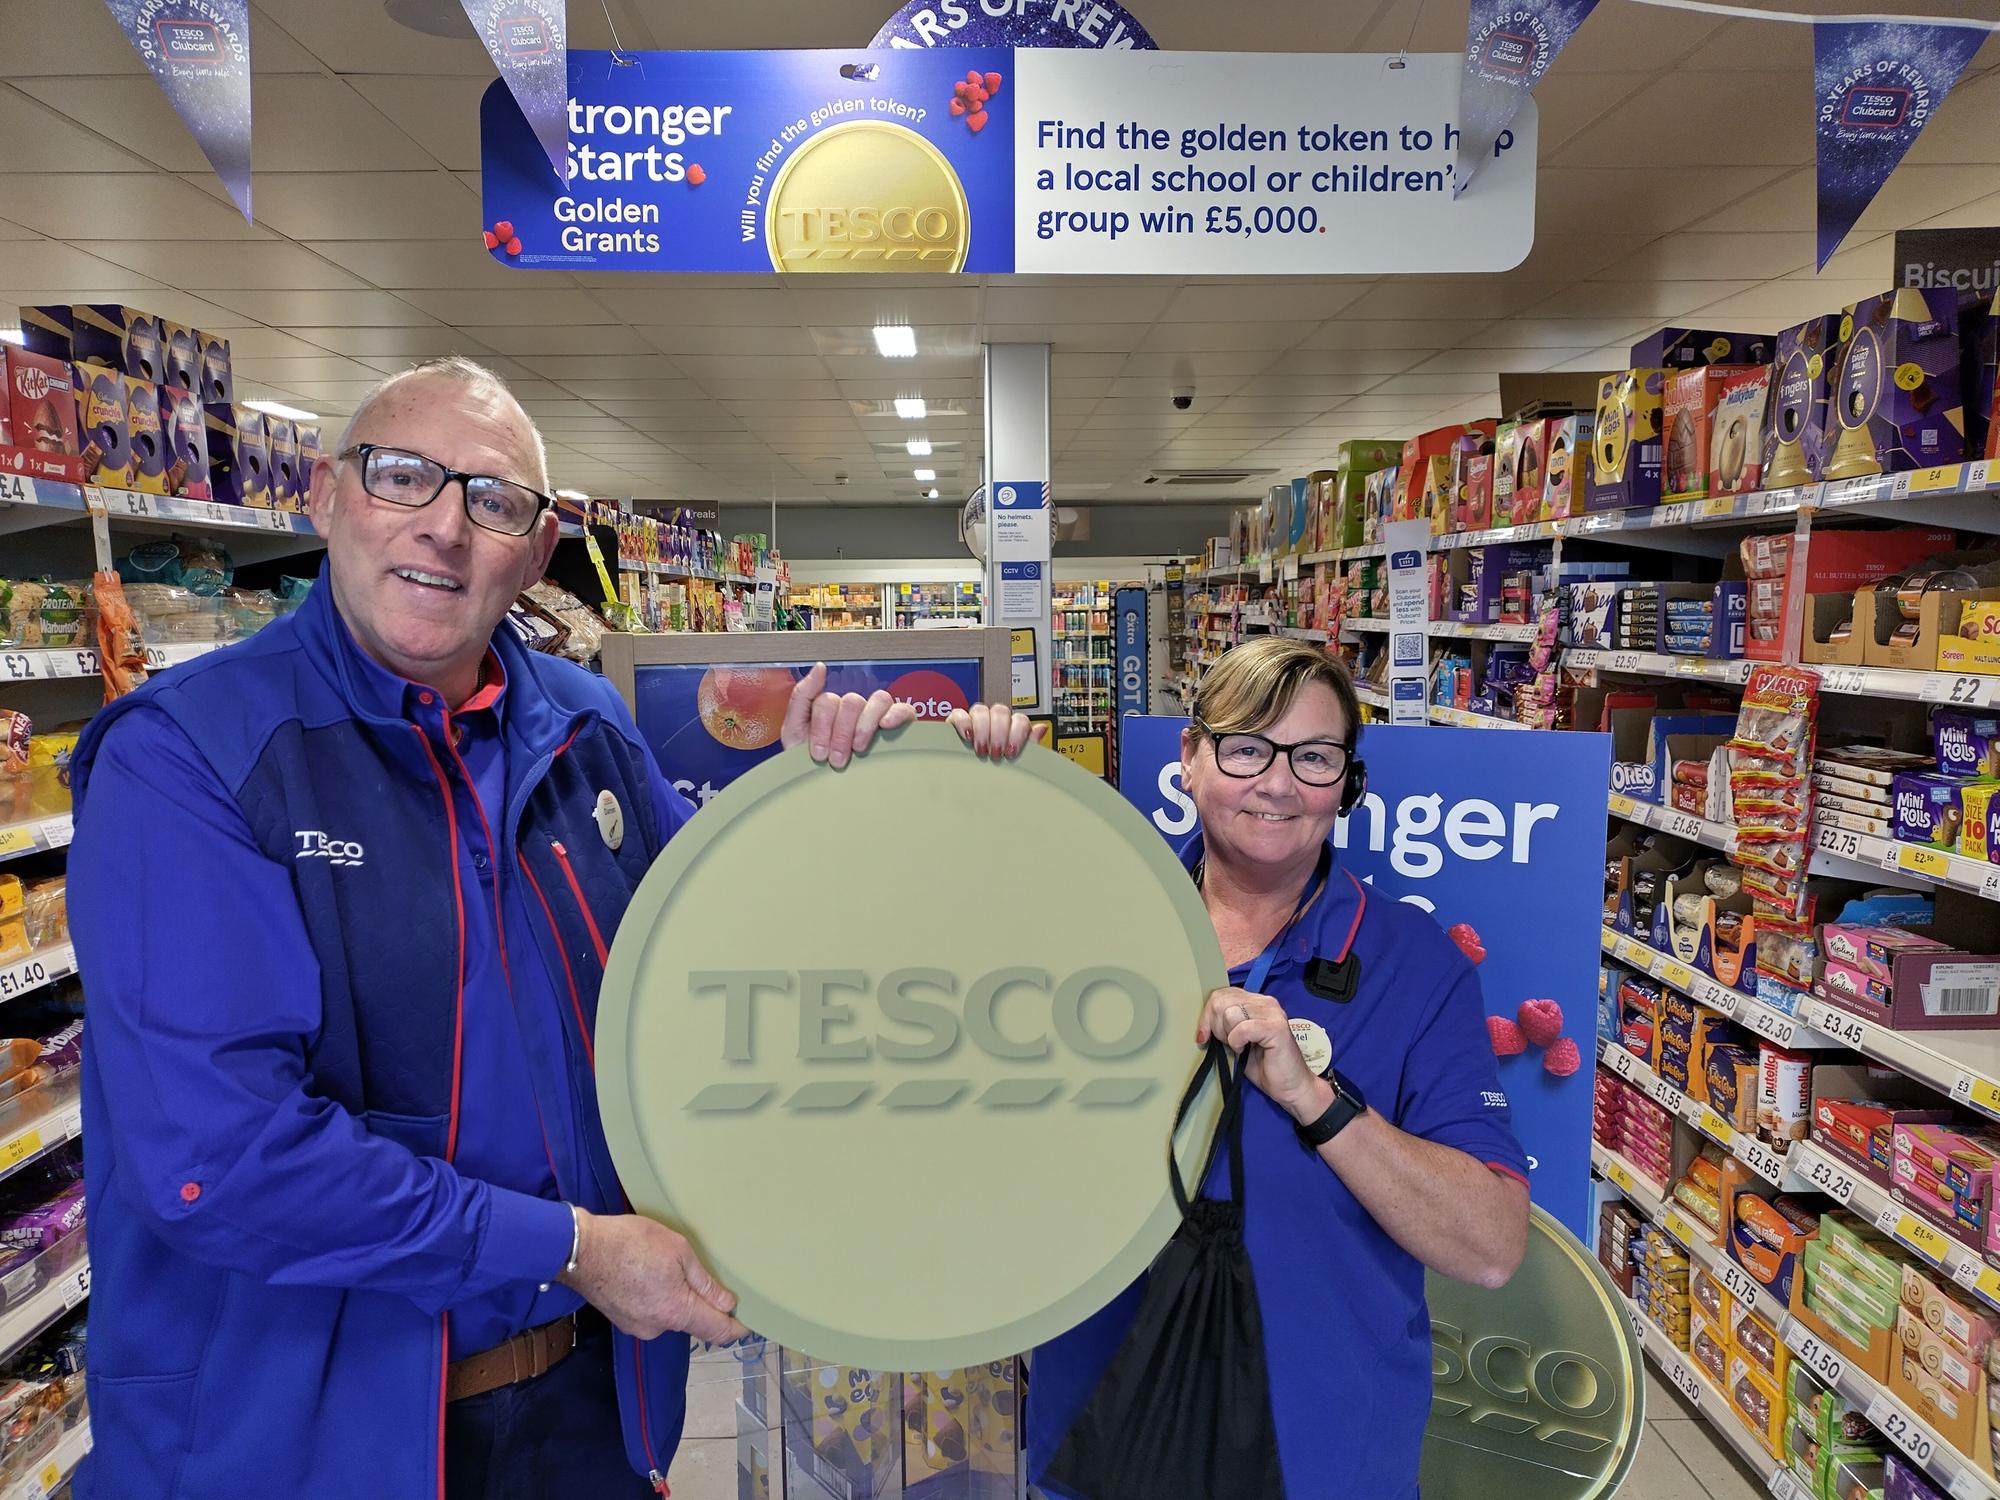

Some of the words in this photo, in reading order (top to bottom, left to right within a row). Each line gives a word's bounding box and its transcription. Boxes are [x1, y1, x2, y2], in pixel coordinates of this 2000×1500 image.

[172, 28, 204, 39] TESCO
[511, 25, 534, 34] TESCO
[140, 40, 157, 59] 30
[171, 40, 215, 52] Clubcard
[488, 39, 501, 57] 30
[510, 36, 542, 46] Clubcard
[1469, 45, 1480, 61] 30
[1475, 12, 1511, 42] YEARS
[1514, 11, 1530, 23] OF
[1528, 17, 1550, 77] REWARDS
[1501, 41, 1523, 52] TESCO
[1491, 50, 1523, 64] Clubcard
[1820, 105, 1834, 122] 30
[1827, 64, 1873, 100] YEARS
[1876, 60, 1898, 73] OF
[1898, 64, 1929, 128] REWARDS
[1862, 95, 1894, 104] TESCO
[810, 97, 865, 127] golden
[869, 95, 927, 124] token?
[1852, 106, 1896, 116] Clubcard
[566, 97, 733, 146] tronger
[781, 118, 808, 143] the
[1038, 120, 1105, 149] Find
[1116, 122, 1170, 150] the
[1181, 123, 1286, 158] golden
[1297, 124, 1388, 151] token
[1399, 125, 1433, 150] to
[1445, 123, 1514, 157] hp
[756, 138, 784, 174] find
[1037, 169, 1054, 190] a
[1066, 163, 1139, 191] local
[1151, 164, 1255, 192] school
[1267, 171, 1302, 192] or
[746, 175, 765, 206] you
[553, 196, 659, 223] Golden
[741, 209, 757, 242] Will
[780, 206, 957, 242] TESCO
[1037, 210, 1129, 240] group
[1140, 205, 1194, 233] win
[1205, 206, 1326, 239] £5,000.
[561, 227, 660, 253] Grants
[1904, 259, 2000, 289] Biscui
[20, 367, 48, 399] KitKat
[92, 405, 121, 419] crunchie
[1604, 406, 1619, 423] Mini
[1603, 420, 1620, 436] eggs
[30, 458, 41, 471] 1x
[1973, 469, 1984, 481] £6
[1897, 480, 1907, 490] £6
[1929, 470, 1942, 481] £4
[0, 475, 25, 501] £4
[127, 492, 149, 516] £4
[692, 509, 717, 519] reals
[1664, 505, 1683, 524] £12
[271, 511, 286, 530] £4
[77, 651, 101, 675] £2
[146, 647, 166, 667] 0p
[1576, 652, 1596, 666] £2.55
[1615, 656, 1638, 670] £2.50
[1942, 650, 1965, 660] Soreen
[5, 654, 35, 678] £2
[1123, 656, 1141, 705] GOT
[1823, 667, 1865, 692] £1.75
[1949, 677, 1981, 703] £2
[895, 696, 952, 718] Vote
[1069, 744, 1085, 754] 1/3
[1942, 743, 1976, 763] ROLLS
[1611, 764, 1655, 790] OREO
[1820, 795, 1843, 811] Galaxy
[1966, 795, 1982, 807] FAMILY
[1151, 761, 1562, 879] Snger
[1818, 810, 1840, 825] Galaxy
[1900, 808, 1931, 828] ROLLS
[1965, 804, 1982, 820] SIZE
[1672, 817, 1701, 837] £1.85
[1964, 820, 1985, 840] 10
[1820, 830, 1857, 855] £2.75
[1965, 840, 1982, 854] PACK
[1886, 851, 1897, 862] £4
[1914, 853, 1934, 864] £2.50
[1986, 877, 1998, 889] £4
[1830, 942, 1856, 961] Kipling
[1, 961, 45, 994] £1.40
[1705, 986, 1737, 1012] £2.50
[687, 966, 1160, 1062] TESCO
[1854, 1003, 1866, 1014] GOOD
[1866, 1008, 1880, 1019] CAKES
[1757, 1014, 1793, 1042] £2.30
[1823, 1013, 1863, 1044] £3.45
[1616, 1055, 1631, 1076] £2
[1765, 1055, 1775, 1098] nutella
[1957, 1080, 1969, 1093] £3
[1480, 1091, 1505, 1104] TESCO
[1655, 1082, 1682, 1110] £1.55
[1797, 1066, 1809, 1110] nutella
[1747, 1146, 1780, 1179] £2.65
[1811, 1163, 1853, 1199] £3.25
[0, 1227, 44, 1241] RUIT
[1913, 1225, 1934, 1240] £1.50
[1931, 1214, 1946, 1228] GOOD
[1945, 1223, 1961, 1236] CAKES
[1724, 1268, 1757, 1305] £1.75
[1431, 1319, 1616, 1419] SCO
[1801, 1339, 1841, 1379] £1.50
[1673, 1364, 1700, 1399] £1.30
[1885, 1413, 1931, 1460] £2.30
